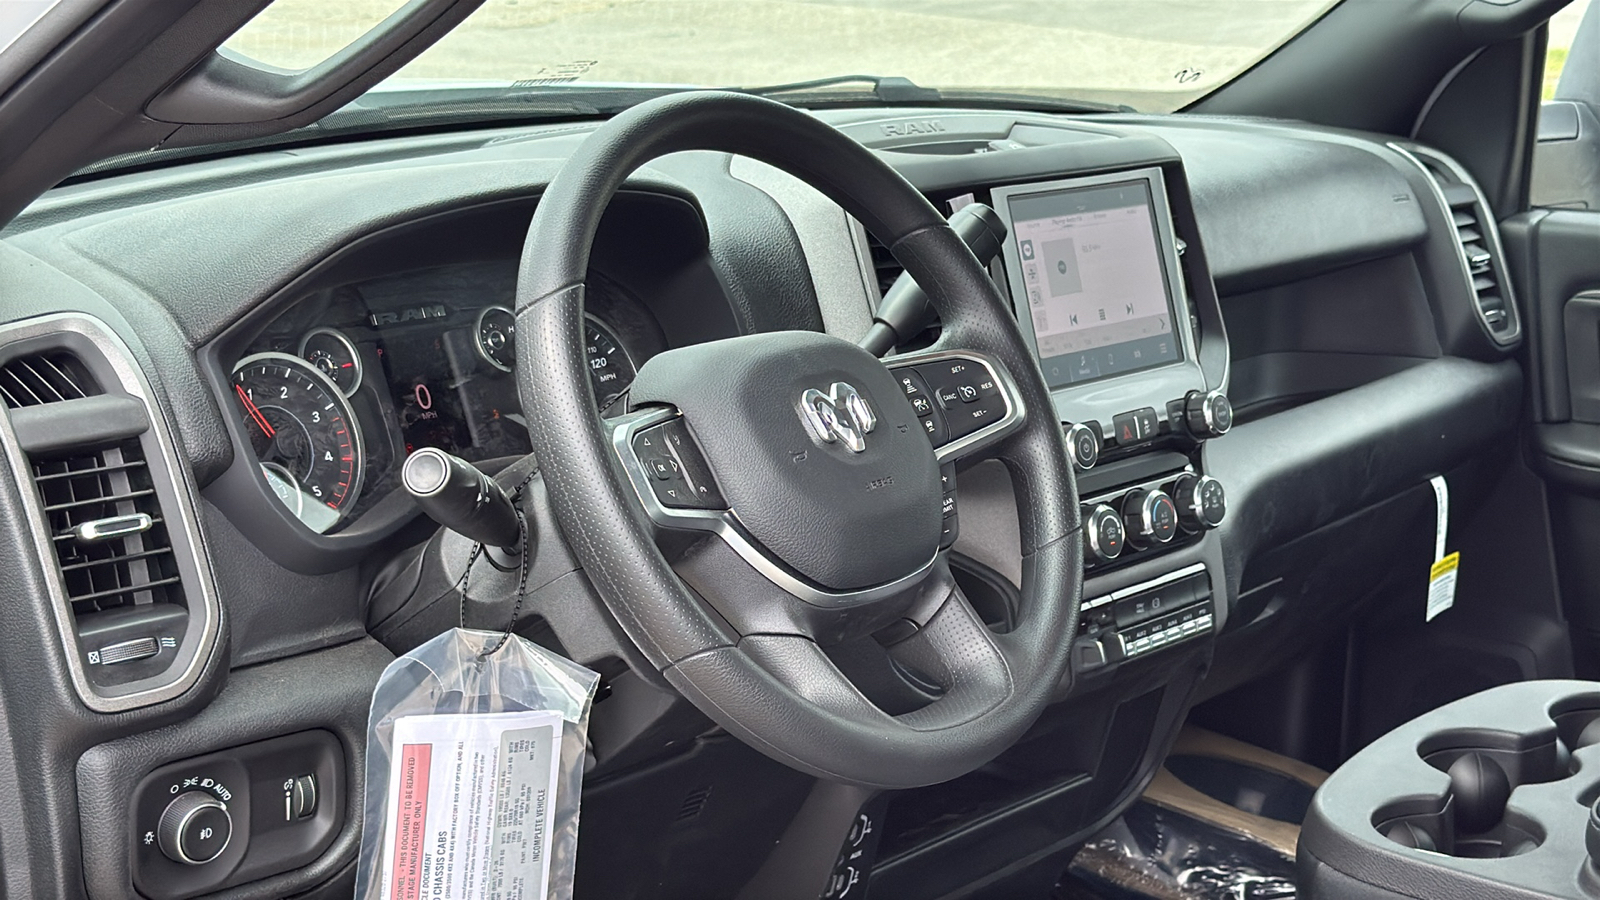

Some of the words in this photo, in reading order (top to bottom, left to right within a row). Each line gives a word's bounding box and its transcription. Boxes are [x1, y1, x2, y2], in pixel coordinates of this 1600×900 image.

[880, 120, 946, 137] RAM
[370, 305, 446, 326] RAM
[590, 357, 608, 369] 120
[600, 373, 616, 382] MPH
[980, 382, 992, 390] RES
[280, 386, 288, 399] 2
[415, 384, 432, 410] 0
[943, 393, 957, 401] CANC
[312, 412, 321, 423] 3
[421, 411, 438, 420] MPH
[324, 451, 334, 462] 4
[312, 486, 322, 498] 5
[942, 498, 954, 506] EAR
[406, 757, 416, 789] REMOVED
[213, 784, 232, 801] AUTO
[405, 790, 413, 799] BE
[404, 801, 412, 810] TO
[414, 800, 422, 818] ONLY
[536, 788, 546, 817] VEHICLE
[401, 813, 410, 850] DOCUMENT
[532, 818, 544, 862] INCOMPLETE
[408, 821, 420, 875] MANUFACTURER
[436, 831, 448, 855] CABS
[400, 852, 408, 867] THIS
[422, 852, 432, 888] DOCUMENT
[432, 857, 446, 895] CHASSIS
[407, 877, 416, 899] STAGE
